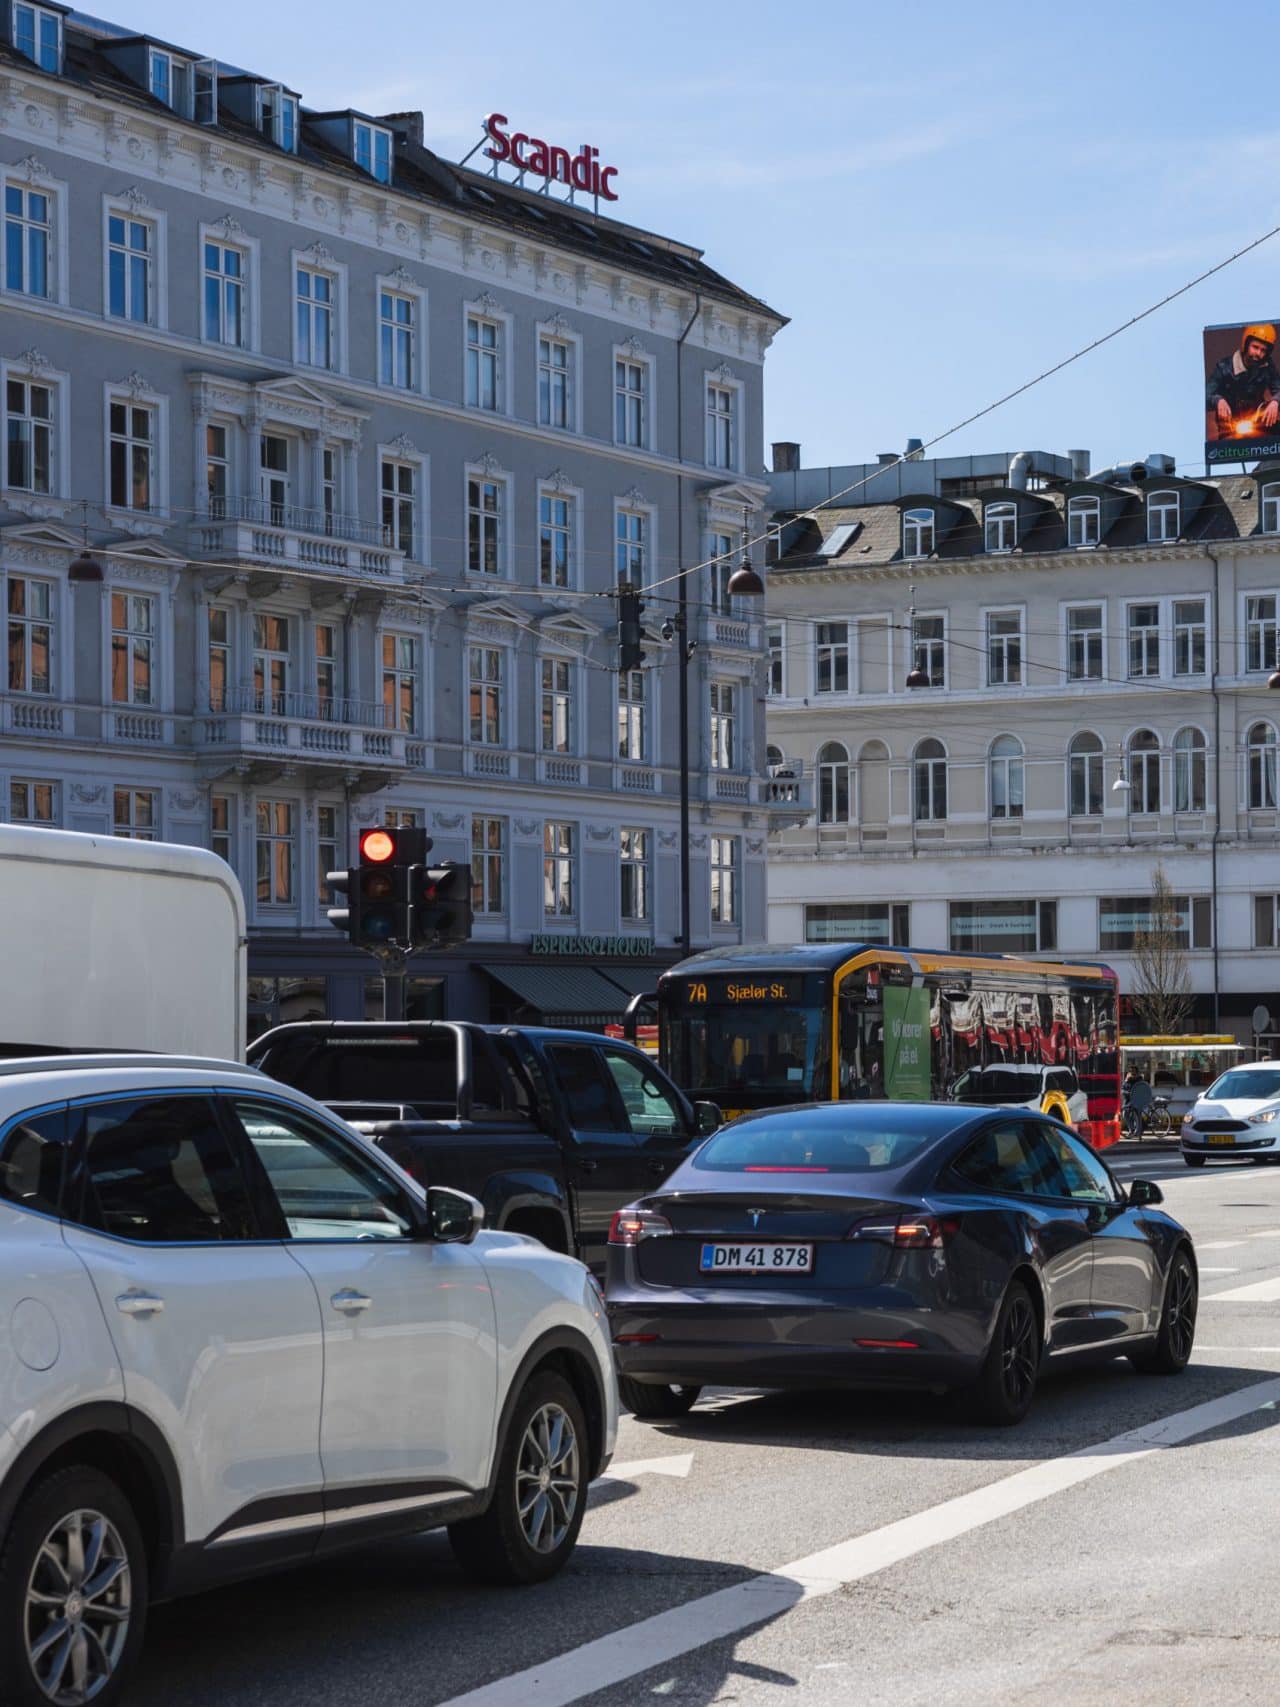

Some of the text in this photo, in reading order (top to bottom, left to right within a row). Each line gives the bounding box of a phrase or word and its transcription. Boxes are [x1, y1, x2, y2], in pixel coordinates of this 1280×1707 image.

[484, 113, 619, 201] Scandic
[531, 934, 656, 957] ESPRESSO HOUSE
[688, 983, 788, 1003] 7A Sjælør St.
[715, 1247, 808, 1266] DM 41 878
